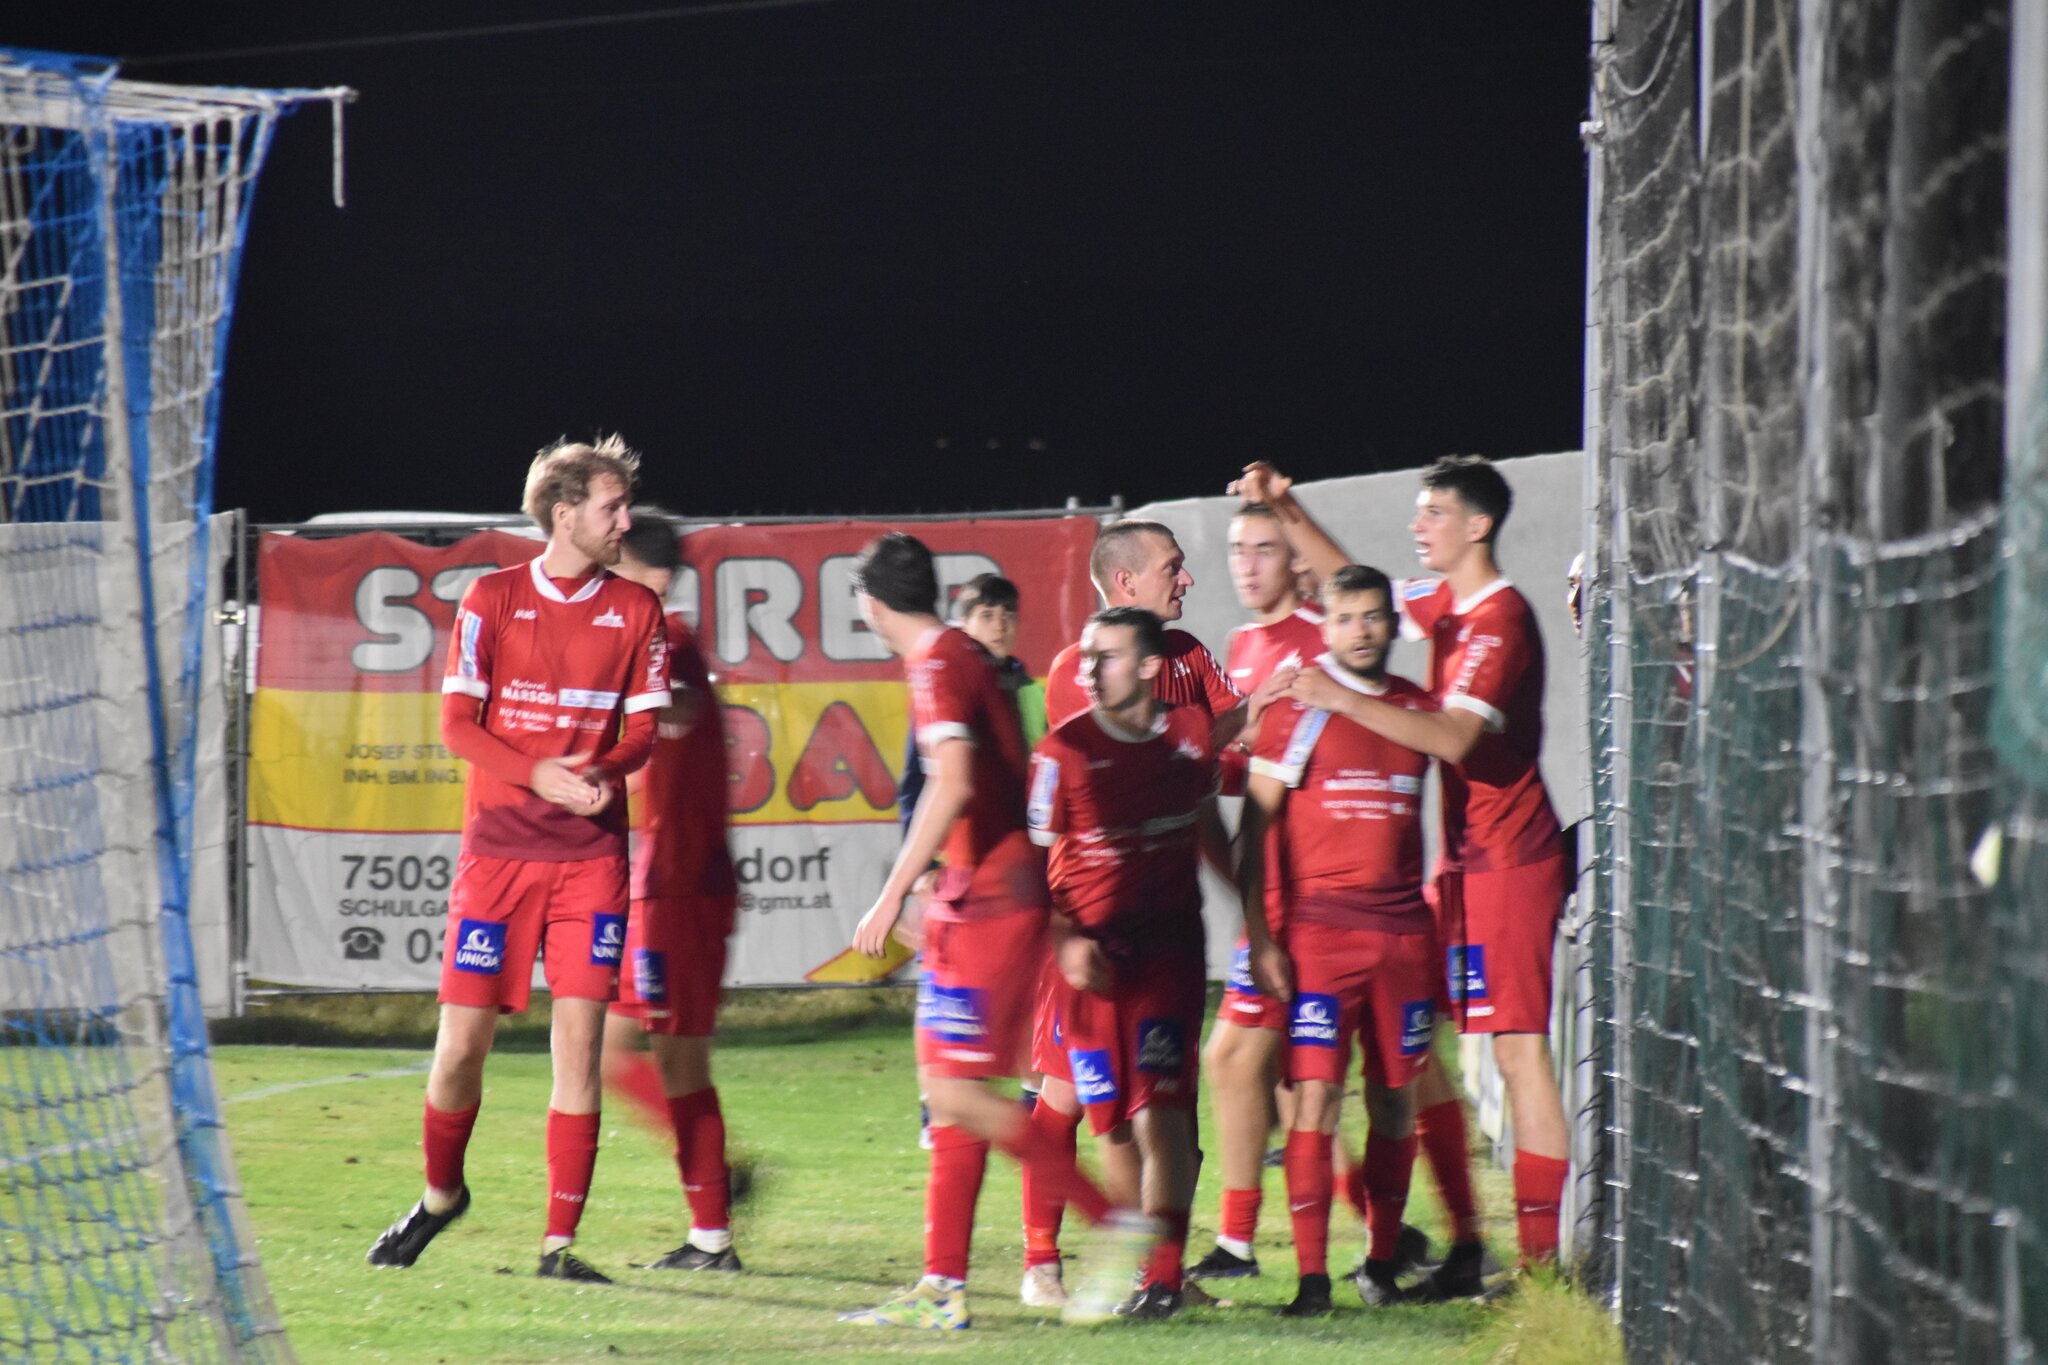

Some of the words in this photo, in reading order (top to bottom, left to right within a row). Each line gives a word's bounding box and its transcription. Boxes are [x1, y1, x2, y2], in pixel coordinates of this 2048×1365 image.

[345, 744, 405, 760] JOSEF
[413, 744, 459, 760] STE
[341, 855, 450, 892] 7503
[735, 847, 830, 884] dorf
[456, 951, 500, 968] UNIQA
